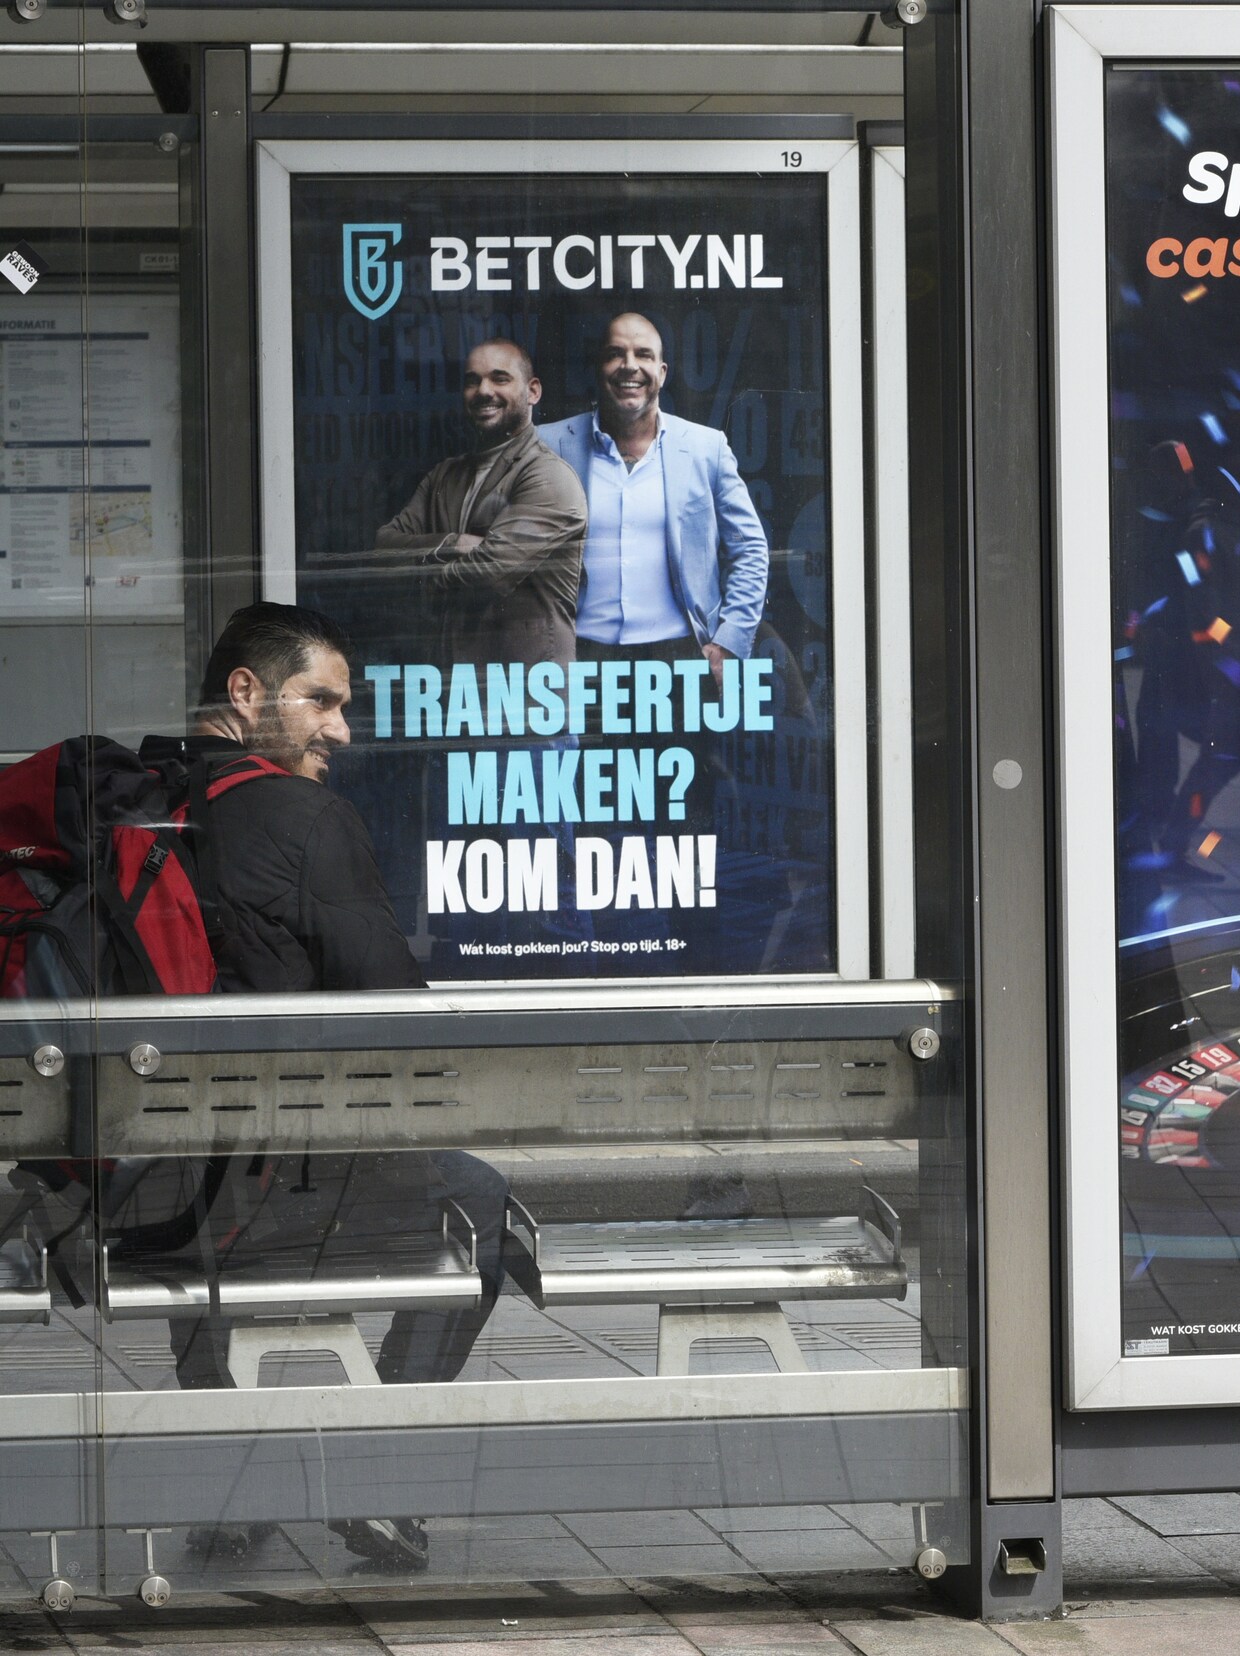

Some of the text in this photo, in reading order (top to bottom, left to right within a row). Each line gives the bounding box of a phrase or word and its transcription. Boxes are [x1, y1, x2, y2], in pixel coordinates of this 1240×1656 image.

[781, 151, 802, 168] 19
[7, 255, 34, 282] RAVES
[430, 234, 784, 291] BETCITY.NL
[364, 658, 774, 738] TRANSFERTJE
[447, 746, 695, 825] MAKEN?
[426, 835, 717, 914] KOM DAN!
[459, 939, 687, 956] Wat kost gokken jou? Stop op tijd. 18+
[1171, 1060, 1206, 1080] 15
[1200, 1048, 1233, 1067] 19
[1151, 1326, 1175, 1335] WAT
[1178, 1325, 1205, 1334] KOST
